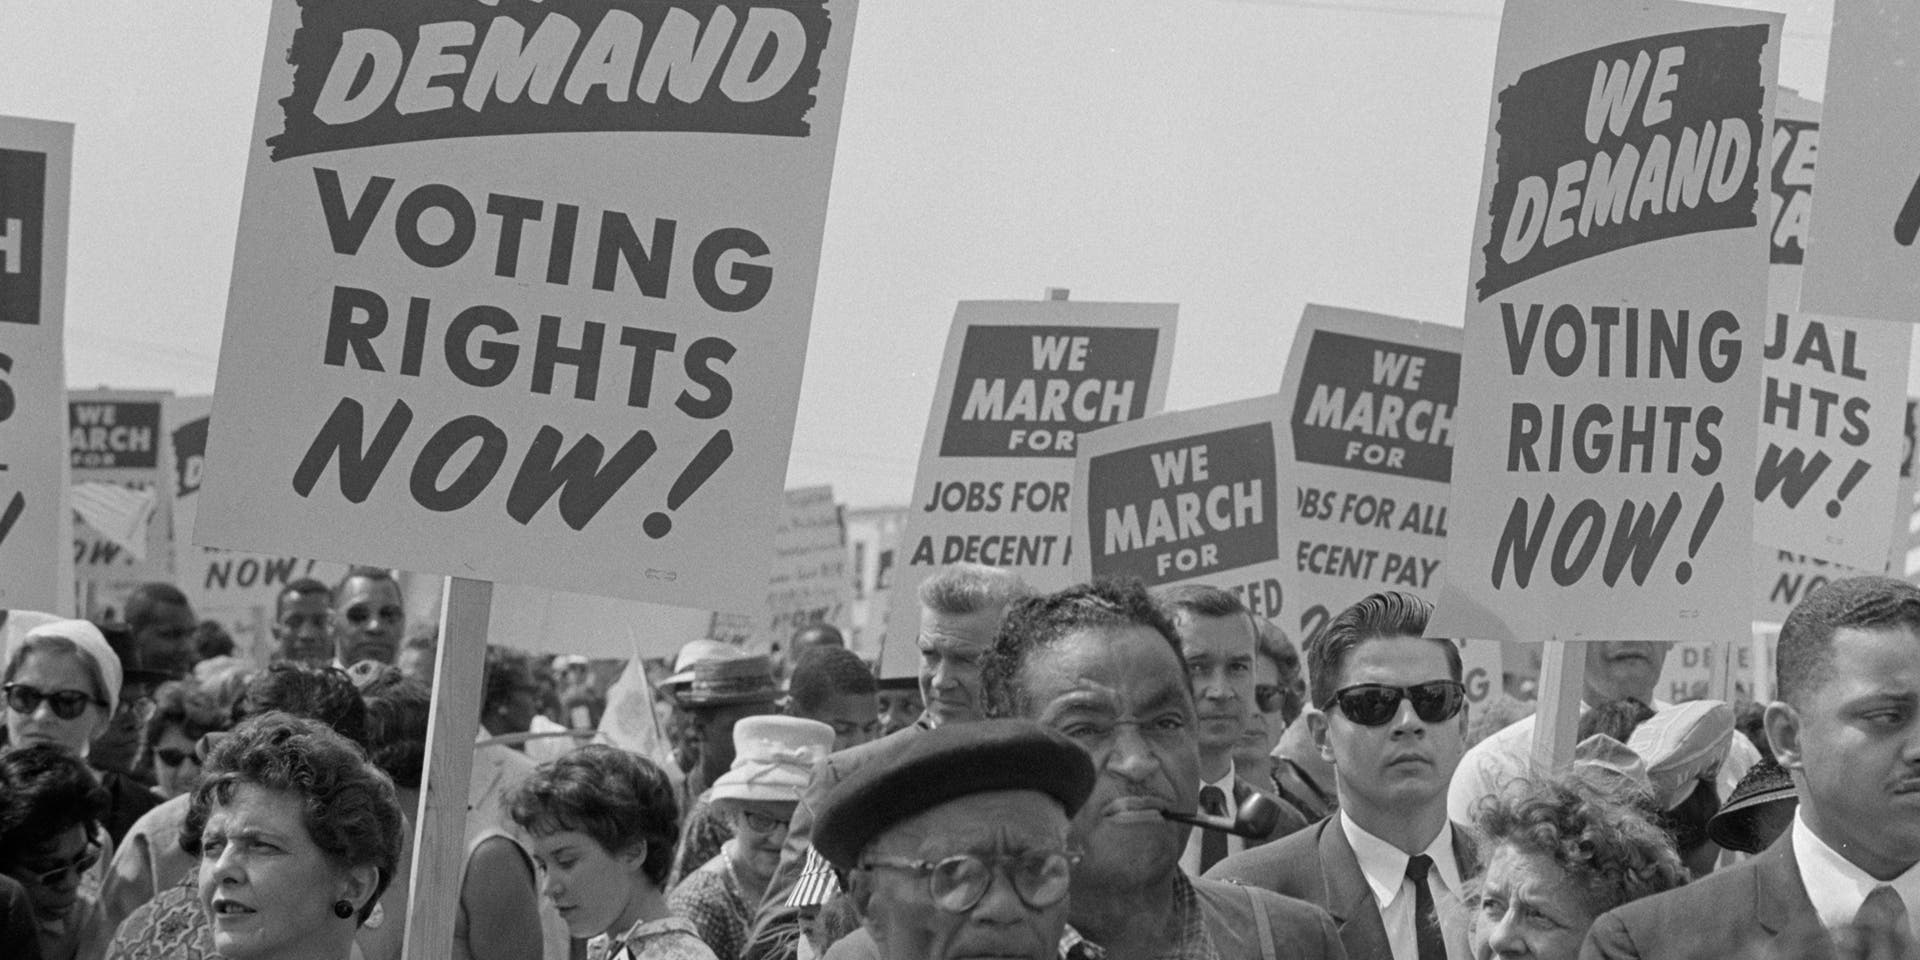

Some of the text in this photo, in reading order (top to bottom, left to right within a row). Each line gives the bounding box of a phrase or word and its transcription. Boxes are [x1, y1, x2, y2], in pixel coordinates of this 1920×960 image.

[313, 5, 806, 125] DEMAND
[1585, 46, 1685, 144] WE
[1501, 118, 1751, 264] DEMAND
[313, 167, 773, 313] VOTING
[324, 286, 737, 420] RIGHTS
[1033, 336, 1089, 371] WE
[1500, 303, 1742, 383] VOTING
[1373, 350, 1426, 391] WE
[76, 405, 116, 426] WE
[962, 378, 1135, 423] MARCH
[1304, 384, 1457, 448] MARCH
[1009, 430, 1073, 451] FOR
[1344, 441, 1405, 468] FOR
[1507, 403, 1723, 476] RIGHTS
[293, 396, 733, 539] NOW!
[1151, 445, 1208, 488] WE
[924, 482, 1070, 512] JOBS FOR
[1104, 479, 1263, 555] MARCH
[1340, 494, 1395, 529] FOR
[1399, 503, 1447, 537] ALL
[910, 536, 934, 565] A
[942, 536, 1057, 566] DECENT
[1492, 482, 1724, 590] NOW!
[1157, 543, 1218, 576] FOR
[1383, 552, 1440, 588] PAY
